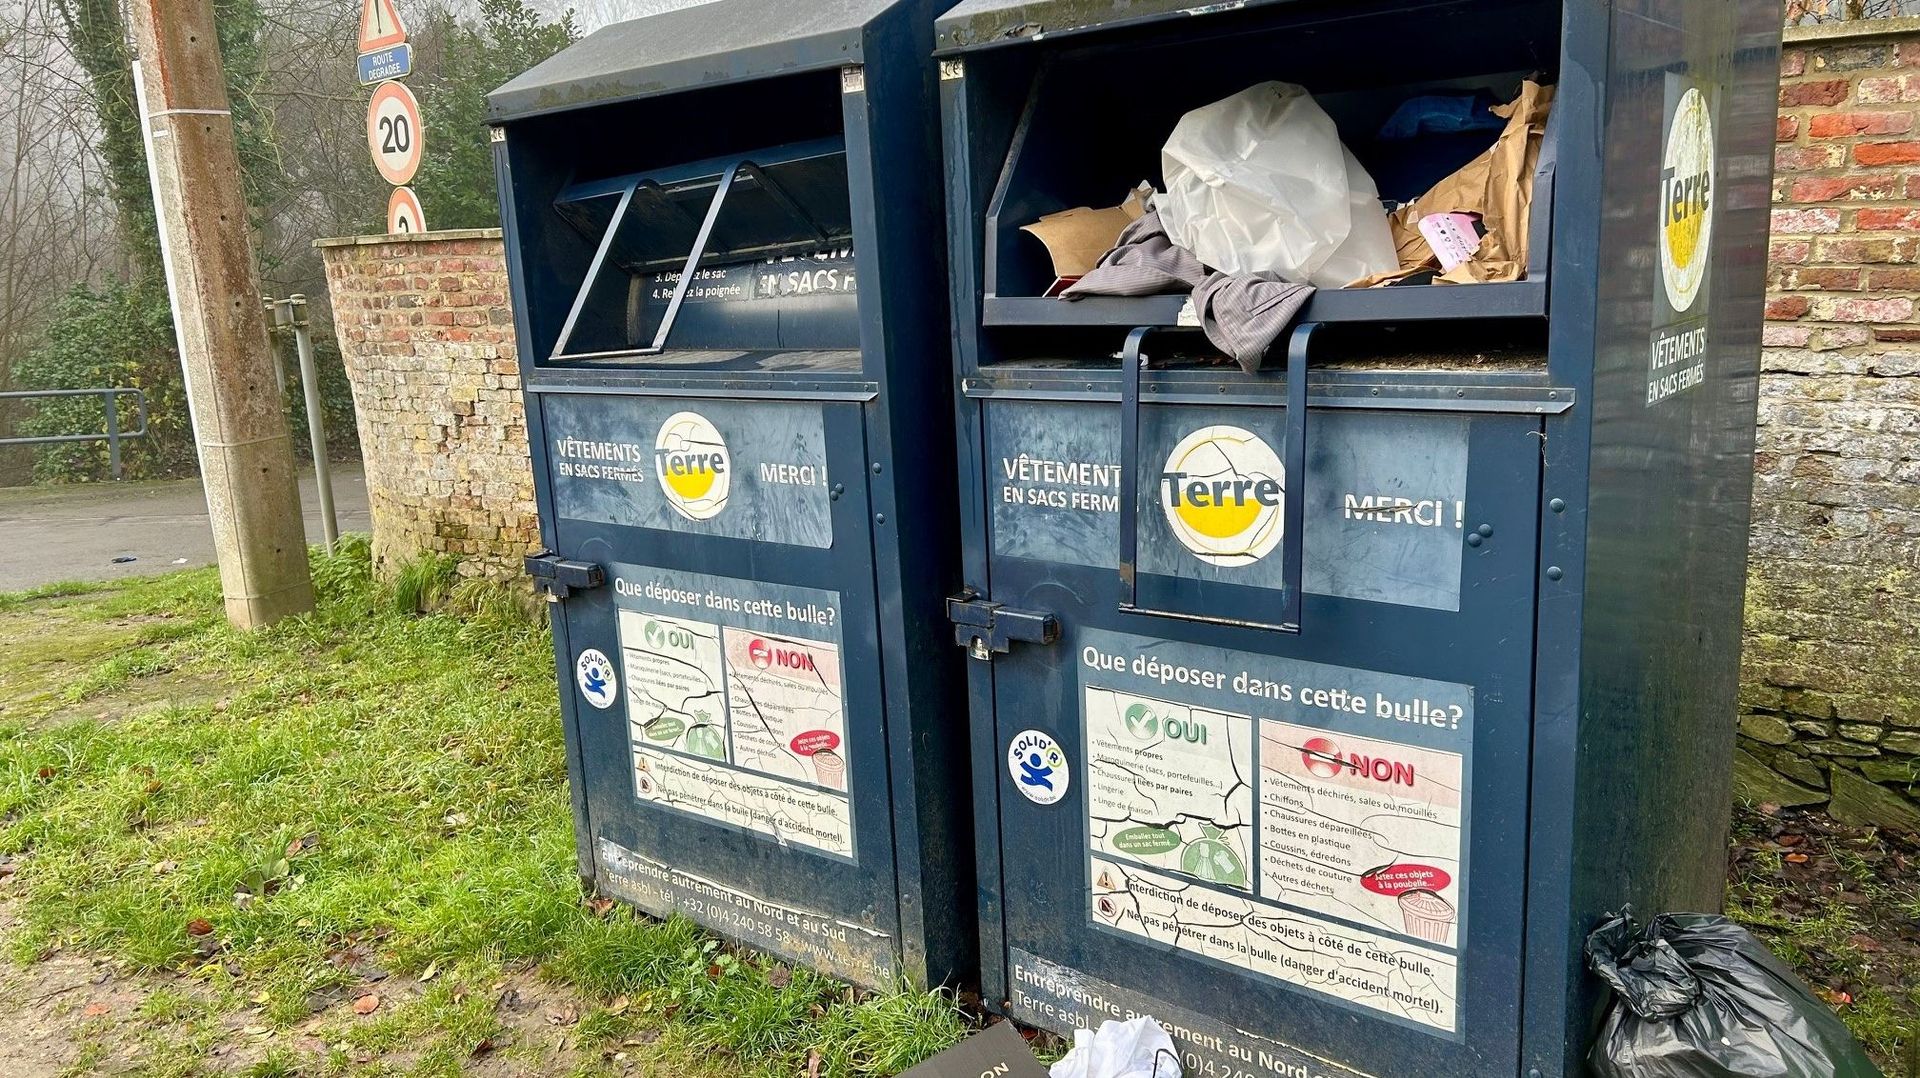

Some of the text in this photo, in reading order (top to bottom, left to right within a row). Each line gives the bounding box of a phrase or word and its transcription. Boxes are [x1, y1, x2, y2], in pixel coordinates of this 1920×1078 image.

[368, 63, 401, 80] DEGRADEE
[372, 52, 394, 66] ROUTE
[378, 114, 410, 154] 20
[1660, 167, 1711, 227] Terre
[655, 273, 663, 282] 3.
[701, 268, 711, 280] le
[711, 269, 727, 279] sac
[787, 269, 838, 292] SACS
[652, 288, 660, 299] 4.
[695, 286, 704, 297] la
[705, 284, 740, 298] poignée
[1652, 327, 1705, 370] VÊTEMENTS
[1648, 358, 1704, 404] EN SACS FERMÉS
[556, 436, 641, 463] VÊTEMENTS
[655, 449, 724, 476] Terre
[559, 463, 644, 483] EN SACS FERMÉS
[760, 462, 816, 486] MERCI
[1002, 453, 1122, 488] VÊTEMENT
[1003, 486, 1119, 513] EN SACS FERM
[1162, 471, 1280, 508] Terre
[1345, 494, 1443, 527] MERCI
[614, 577, 836, 627] Que déposer dans cette bulle?
[668, 629, 695, 650] OUI
[776, 649, 814, 672] NON
[1083, 646, 1464, 730] Que déposer dans cette bulle?
[1164, 717, 1208, 746] OUI
[1096, 739, 1164, 762] Vêtements propres
[1145, 765, 1166, 778] (sacs,
[1350, 752, 1415, 788] NON
[668, 788, 679, 797] pas
[707, 801, 724, 810] dans
[691, 772, 700, 780] de
[701, 775, 728, 790] déposer
[728, 782, 741, 791] des
[770, 792, 786, 803] côté
[787, 796, 797, 805] de
[797, 800, 816, 811] cette
[1097, 782, 1125, 797] Lingerie
[1137, 777, 1155, 789] liées
[1155, 783, 1169, 793] par
[1169, 785, 1194, 798] paires
[1269, 777, 1438, 821] Vêtements déchirés, sales ou mouillés
[1269, 792, 1304, 808] Chiffons
[1098, 796, 1116, 809] Linge
[1116, 801, 1127, 810] de
[1269, 809, 1373, 840] Chaussures dépareillées
[1270, 824, 1352, 851] Bottes en plastique
[1270, 840, 1352, 867] Coussins, édredons
[1270, 855, 1353, 884] Déchets de couture
[1271, 871, 1335, 894] Autres déchets
[631, 882, 651, 897] asbl
[659, 888, 674, 904] tél
[683, 899, 704, 914] +32
[706, 903, 730, 925] (0)4
[733, 911, 754, 933] 240
[757, 921, 773, 938] 58
[775, 926, 791, 944] 58
[671, 873, 733, 904] autrement
[735, 895, 750, 909] au
[753, 902, 784, 922] Nord
[786, 912, 800, 927] et
[802, 918, 818, 934] au
[821, 922, 847, 943] Sud
[1186, 897, 1199, 909] de
[1201, 900, 1243, 923] déposer
[1248, 915, 1267, 930] des
[1269, 923, 1305, 942] objets
[1308, 931, 1315, 943] à
[1318, 935, 1344, 950] côté
[1347, 943, 1362, 957] de
[1365, 951, 1396, 967] cette
[1399, 957, 1435, 978] bulle.
[1127, 909, 1443, 1014] Ne pas pénétrer dans la bulle (danger d'accident mortel).
[1015, 964, 1121, 1017] Entreprendre
[1228, 1043, 1252, 1063] au
[1258, 1050, 1307, 1077] Nord
[1015, 989, 1054, 1017] Terre
[1058, 1009, 1089, 1030] asbl
[1181, 1049, 1215, 1077] (0)4
